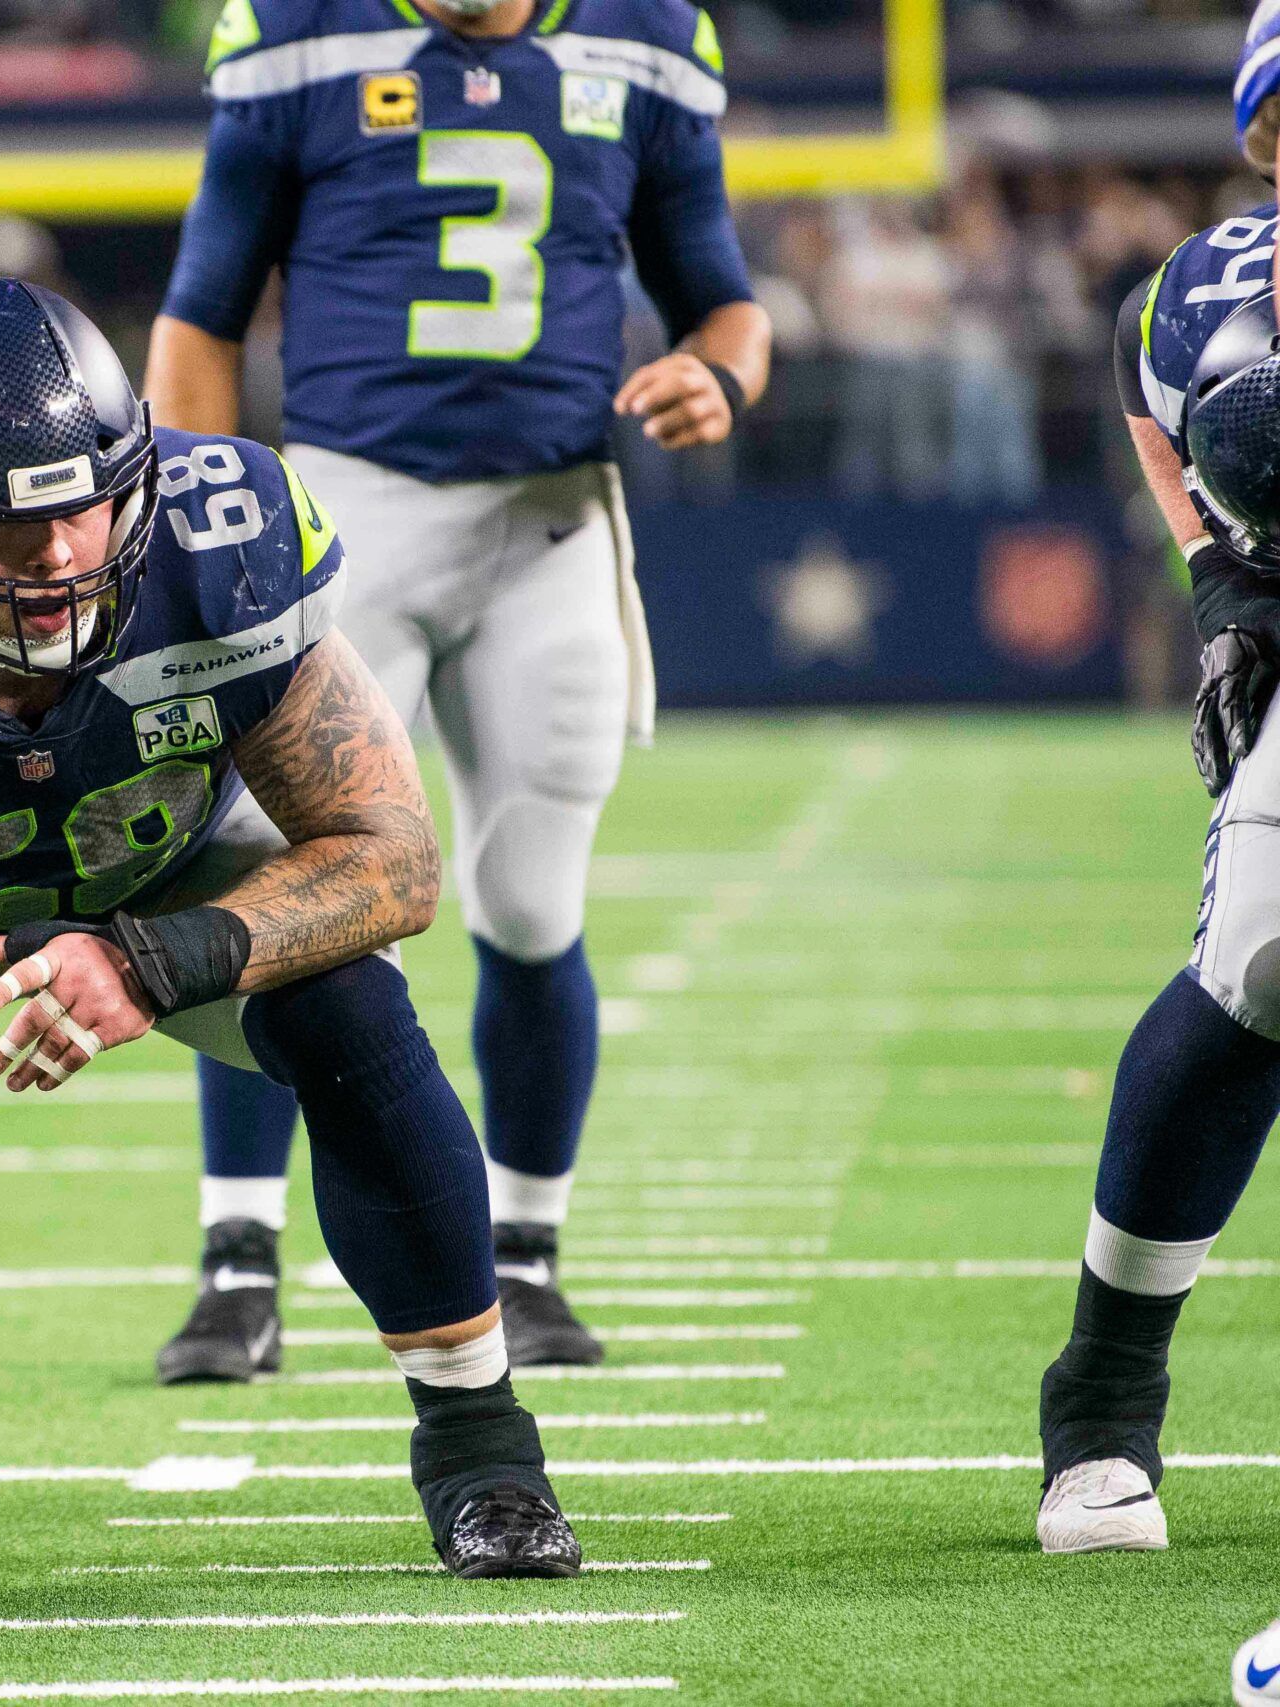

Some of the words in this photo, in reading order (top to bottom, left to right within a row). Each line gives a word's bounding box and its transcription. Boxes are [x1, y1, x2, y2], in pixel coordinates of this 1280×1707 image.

[364, 76, 417, 117] C
[407, 130, 553, 361] 3
[30, 467, 76, 488] SEAHAWKS
[158, 443, 265, 552] 68
[161, 634, 285, 680] SEAHAWKS
[162, 709, 182, 726] 12
[144, 721, 216, 754] PGA
[23, 763, 51, 778] NFL
